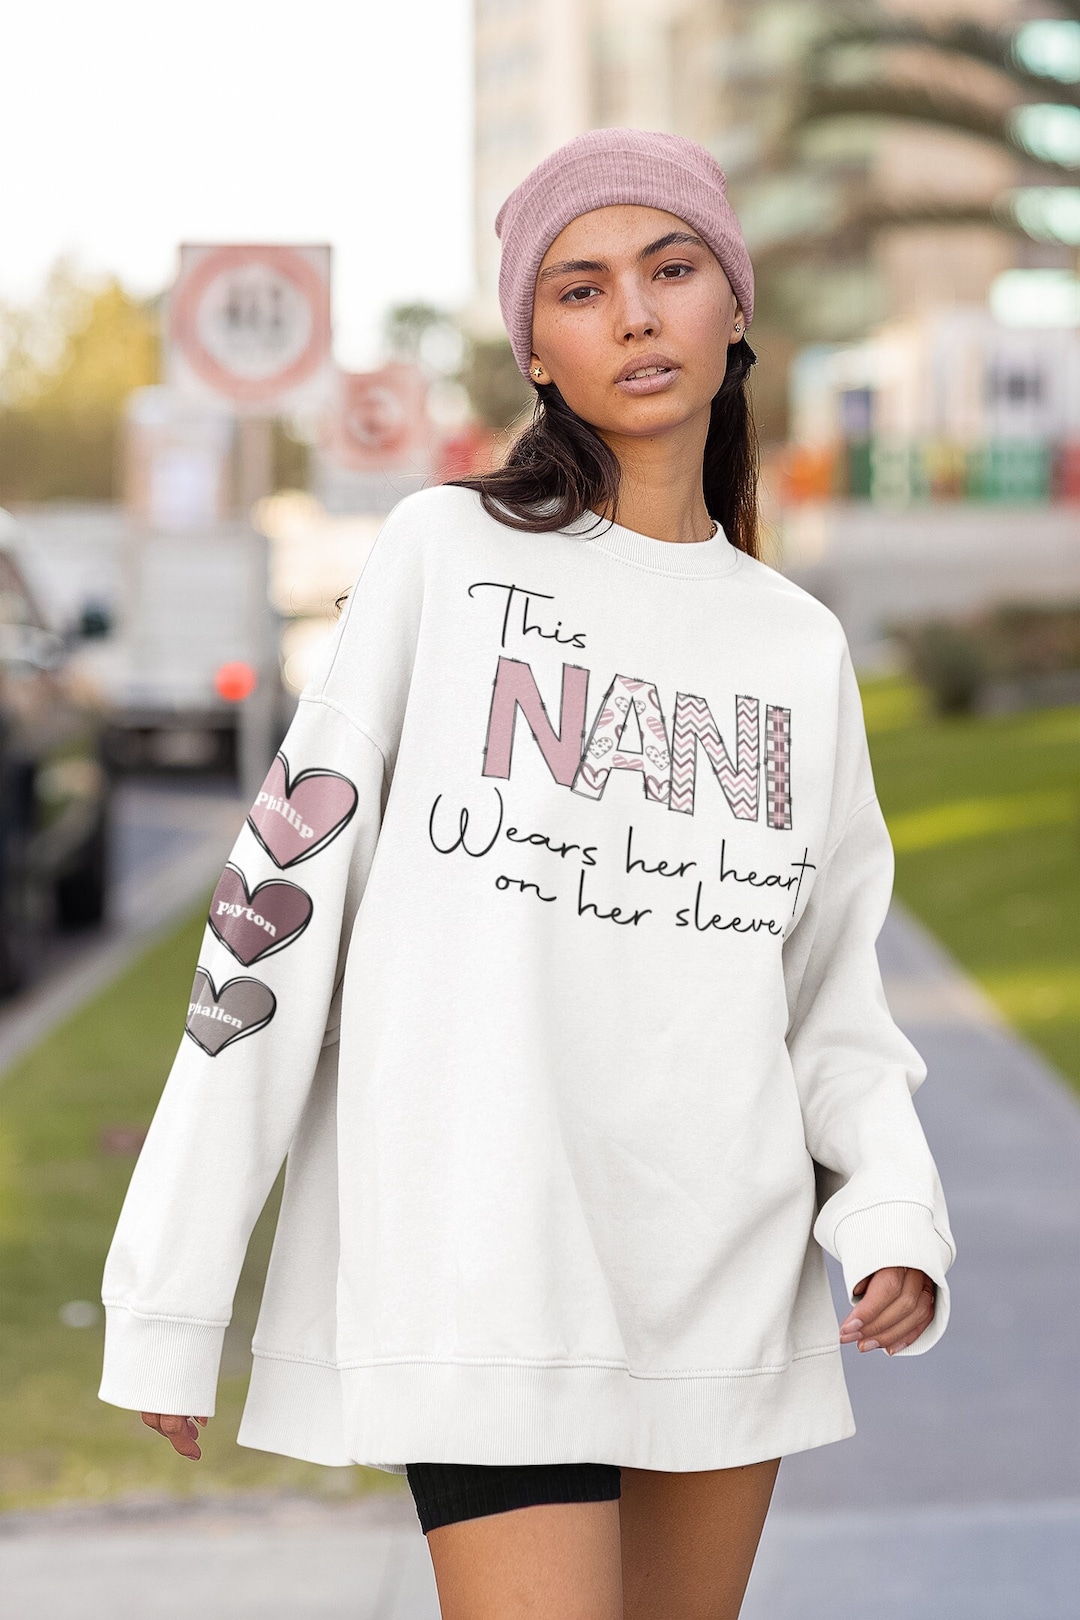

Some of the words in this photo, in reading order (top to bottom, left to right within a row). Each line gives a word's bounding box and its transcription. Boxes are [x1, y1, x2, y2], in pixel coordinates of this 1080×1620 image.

[468, 582, 587, 649] This
[481, 655, 793, 831] NANI
[254, 791, 314, 839] Phillip
[429, 787, 598, 866] Wears
[625, 826, 697, 877] her
[719, 838, 817, 918] heart
[495, 874, 557, 901] on
[577, 869, 652, 925] her
